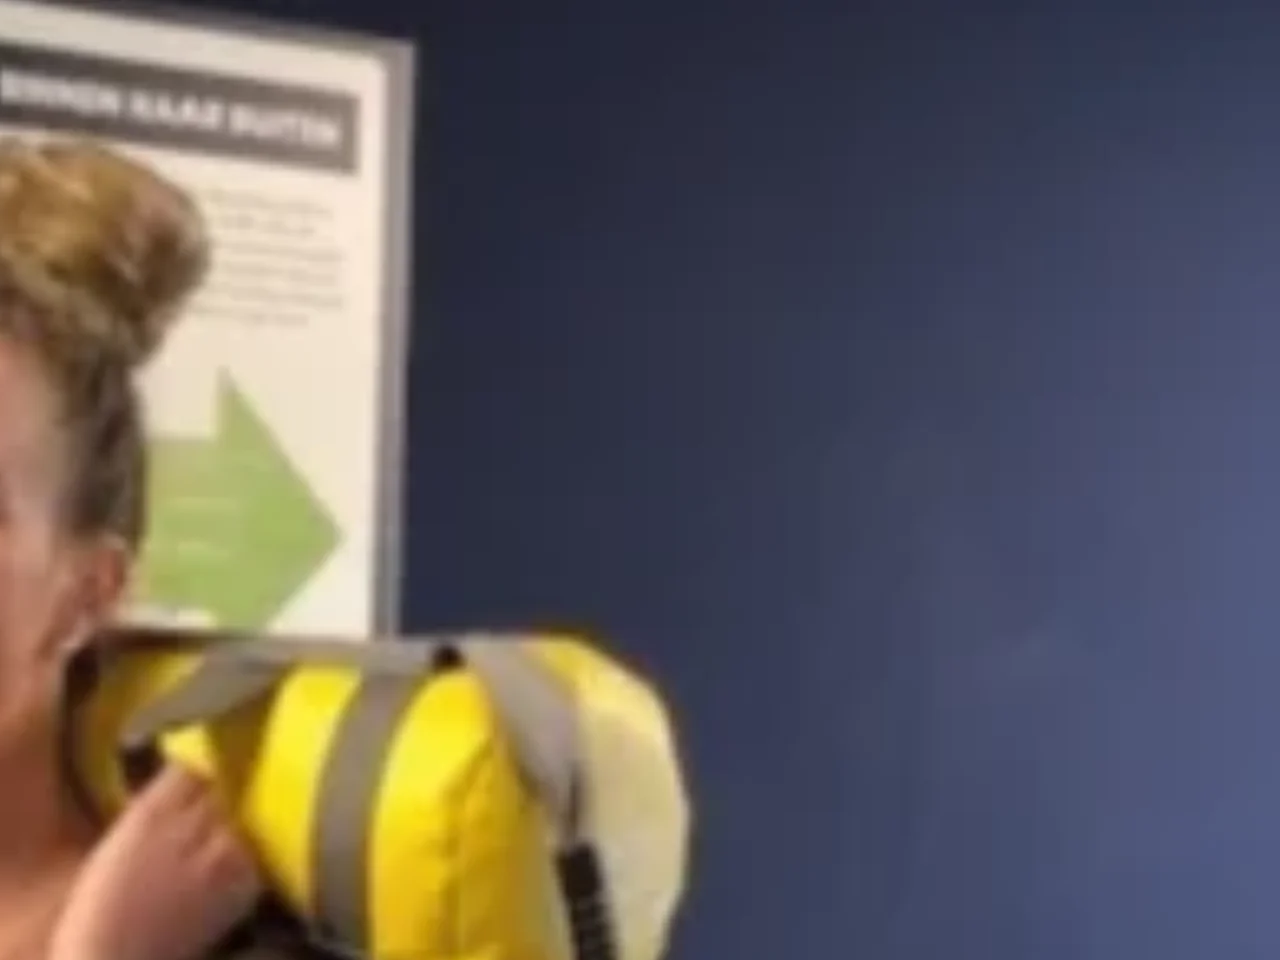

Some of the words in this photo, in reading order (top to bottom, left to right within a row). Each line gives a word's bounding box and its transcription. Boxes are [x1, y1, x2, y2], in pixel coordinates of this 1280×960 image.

[0, 70, 120, 116] BINNEN
[129, 91, 220, 128] NAAR
[227, 106, 342, 148] BUITEN
